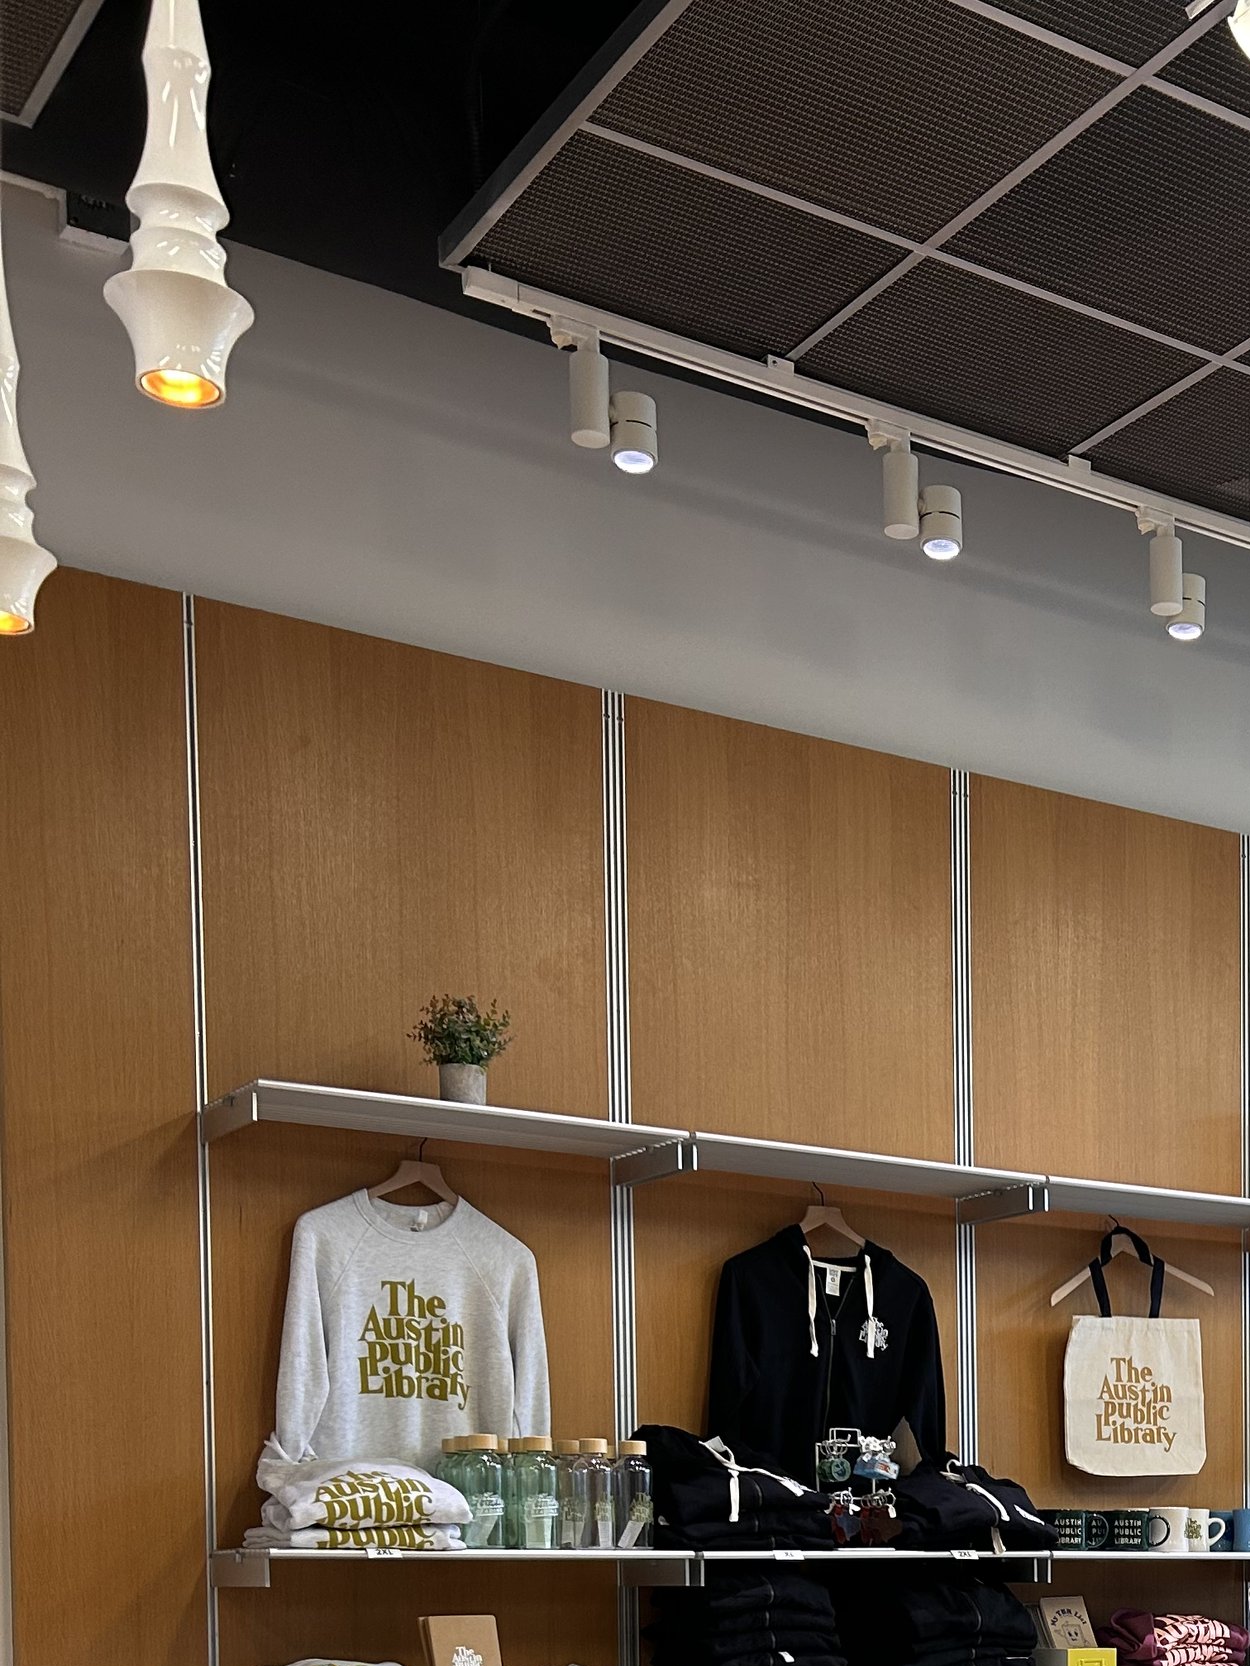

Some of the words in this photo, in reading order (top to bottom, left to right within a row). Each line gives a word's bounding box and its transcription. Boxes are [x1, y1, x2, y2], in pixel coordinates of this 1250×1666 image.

[381, 1278, 446, 1318] The
[358, 1304, 465, 1353] Austin
[1110, 1355, 1153, 1383] The
[358, 1357, 472, 1410] Library
[1097, 1374, 1172, 1407] Austin
[1095, 1413, 1177, 1453] Library
[313, 1478, 434, 1504] Austin
[1054, 1518, 1082, 1526] AUSTIN
[1114, 1519, 1142, 1527] AUSTIN
[1114, 1528, 1142, 1536] PUBLIC
[455, 1646, 474, 1656] The
